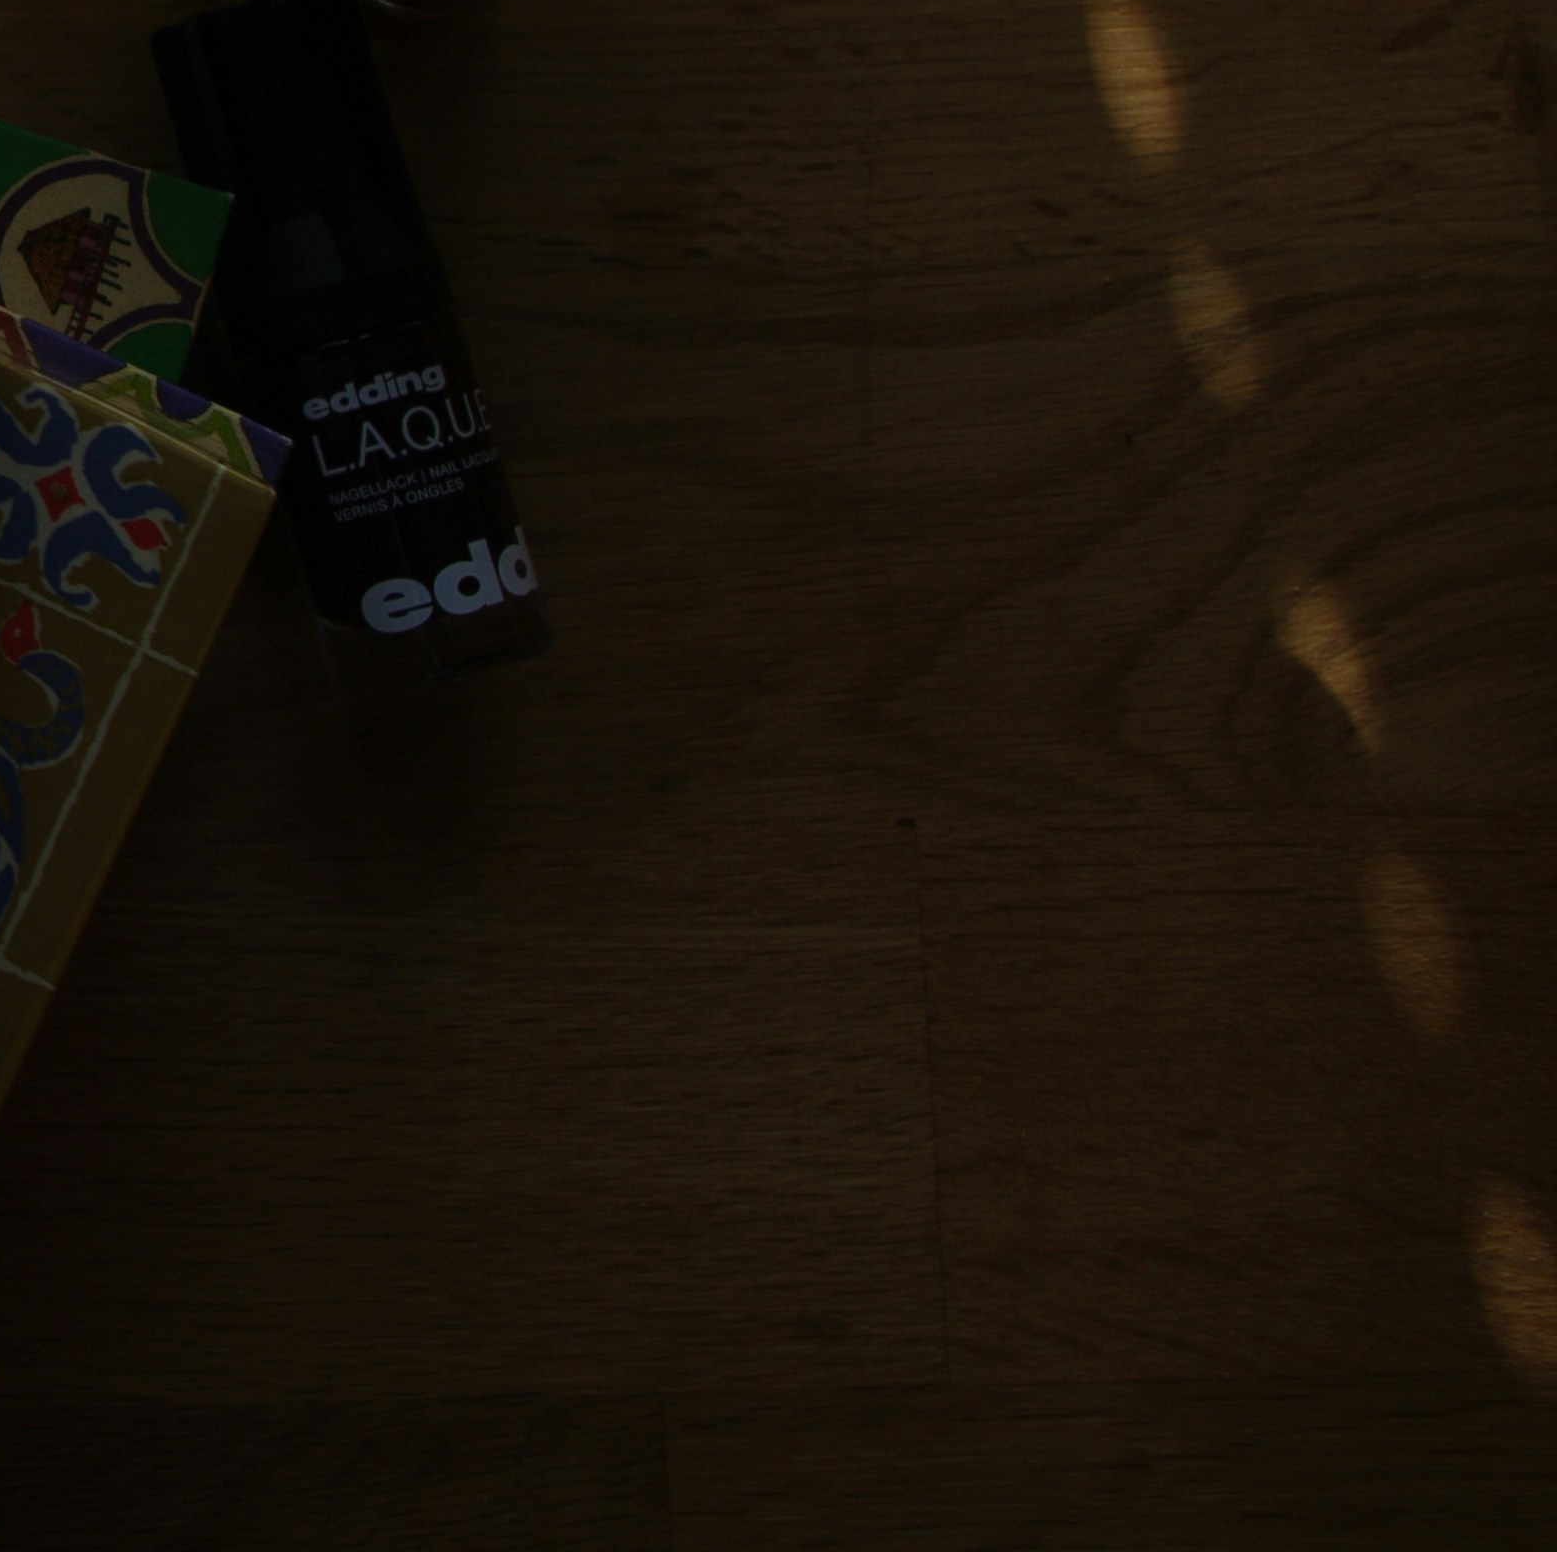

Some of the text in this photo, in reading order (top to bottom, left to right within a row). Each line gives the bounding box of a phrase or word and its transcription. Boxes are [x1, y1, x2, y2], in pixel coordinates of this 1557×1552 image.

[303, 364, 446, 421] edding
[329, 472, 418, 507] NAGELLACK
[429, 460, 462, 479] NAIL
[334, 499, 388, 524] VERNIS
[406, 476, 465, 505] ONGLES
